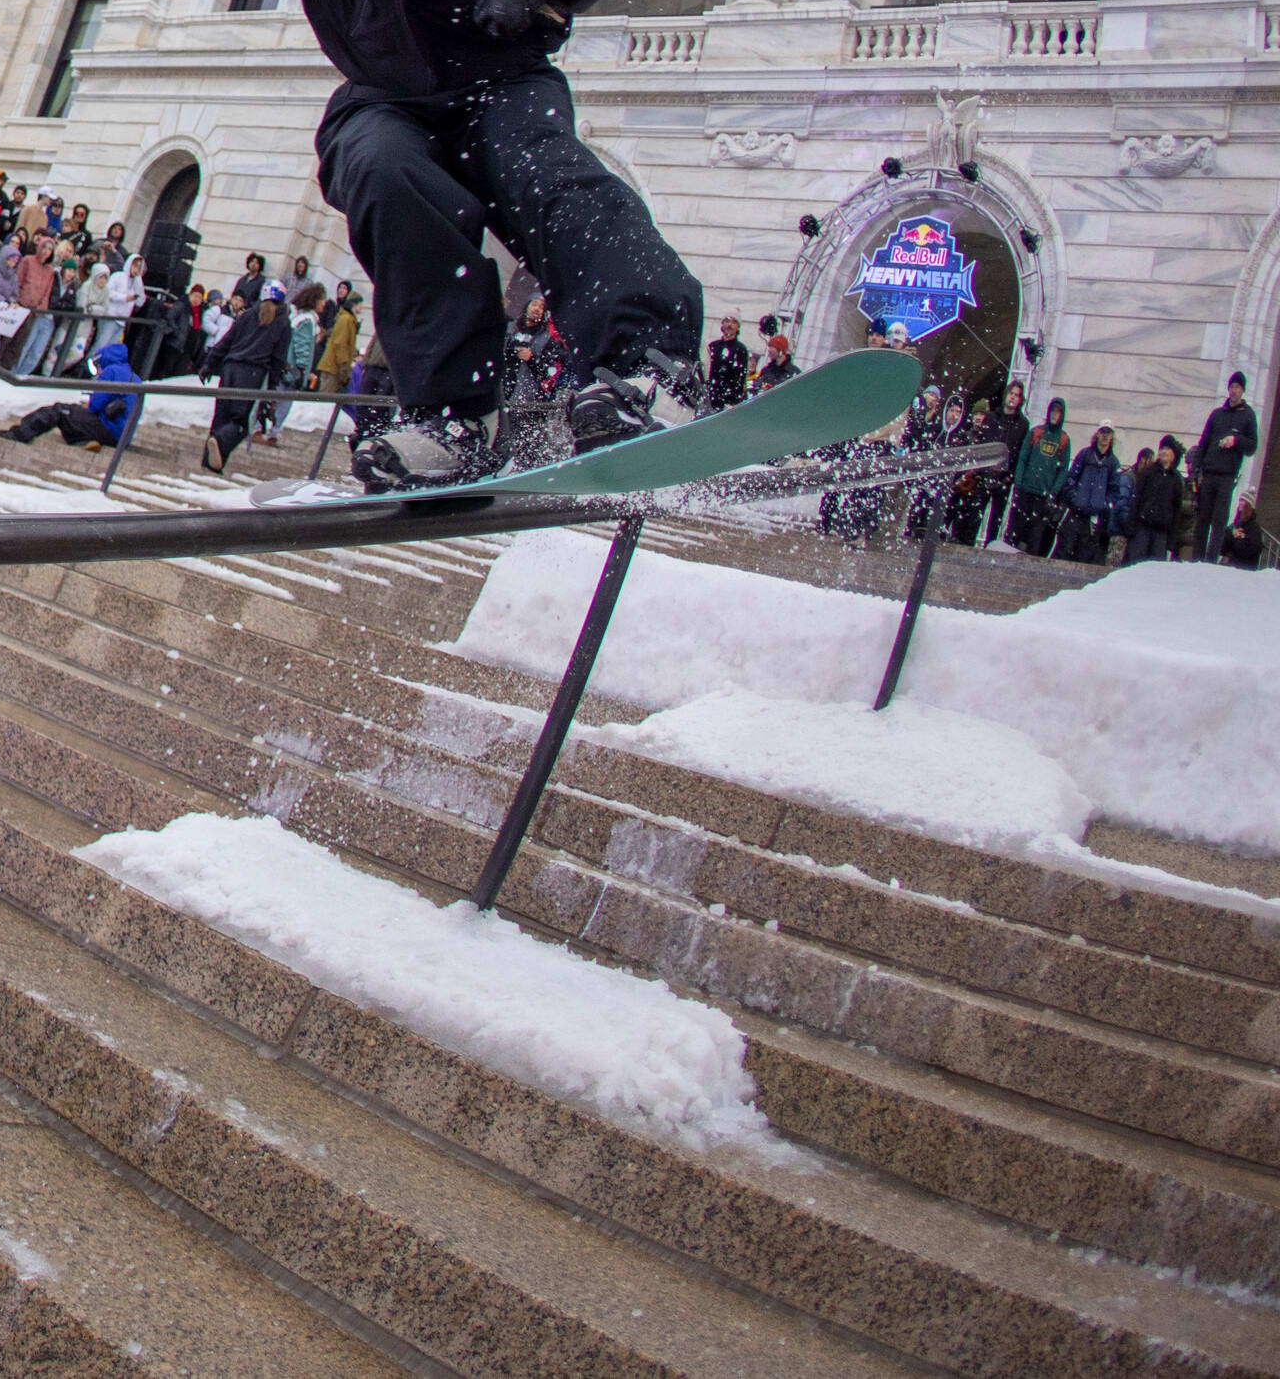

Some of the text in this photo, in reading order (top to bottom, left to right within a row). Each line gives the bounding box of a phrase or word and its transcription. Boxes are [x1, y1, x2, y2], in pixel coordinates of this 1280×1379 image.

[890, 245, 948, 267] Red Bull
[857, 265, 971, 293] HEAVY METAL
